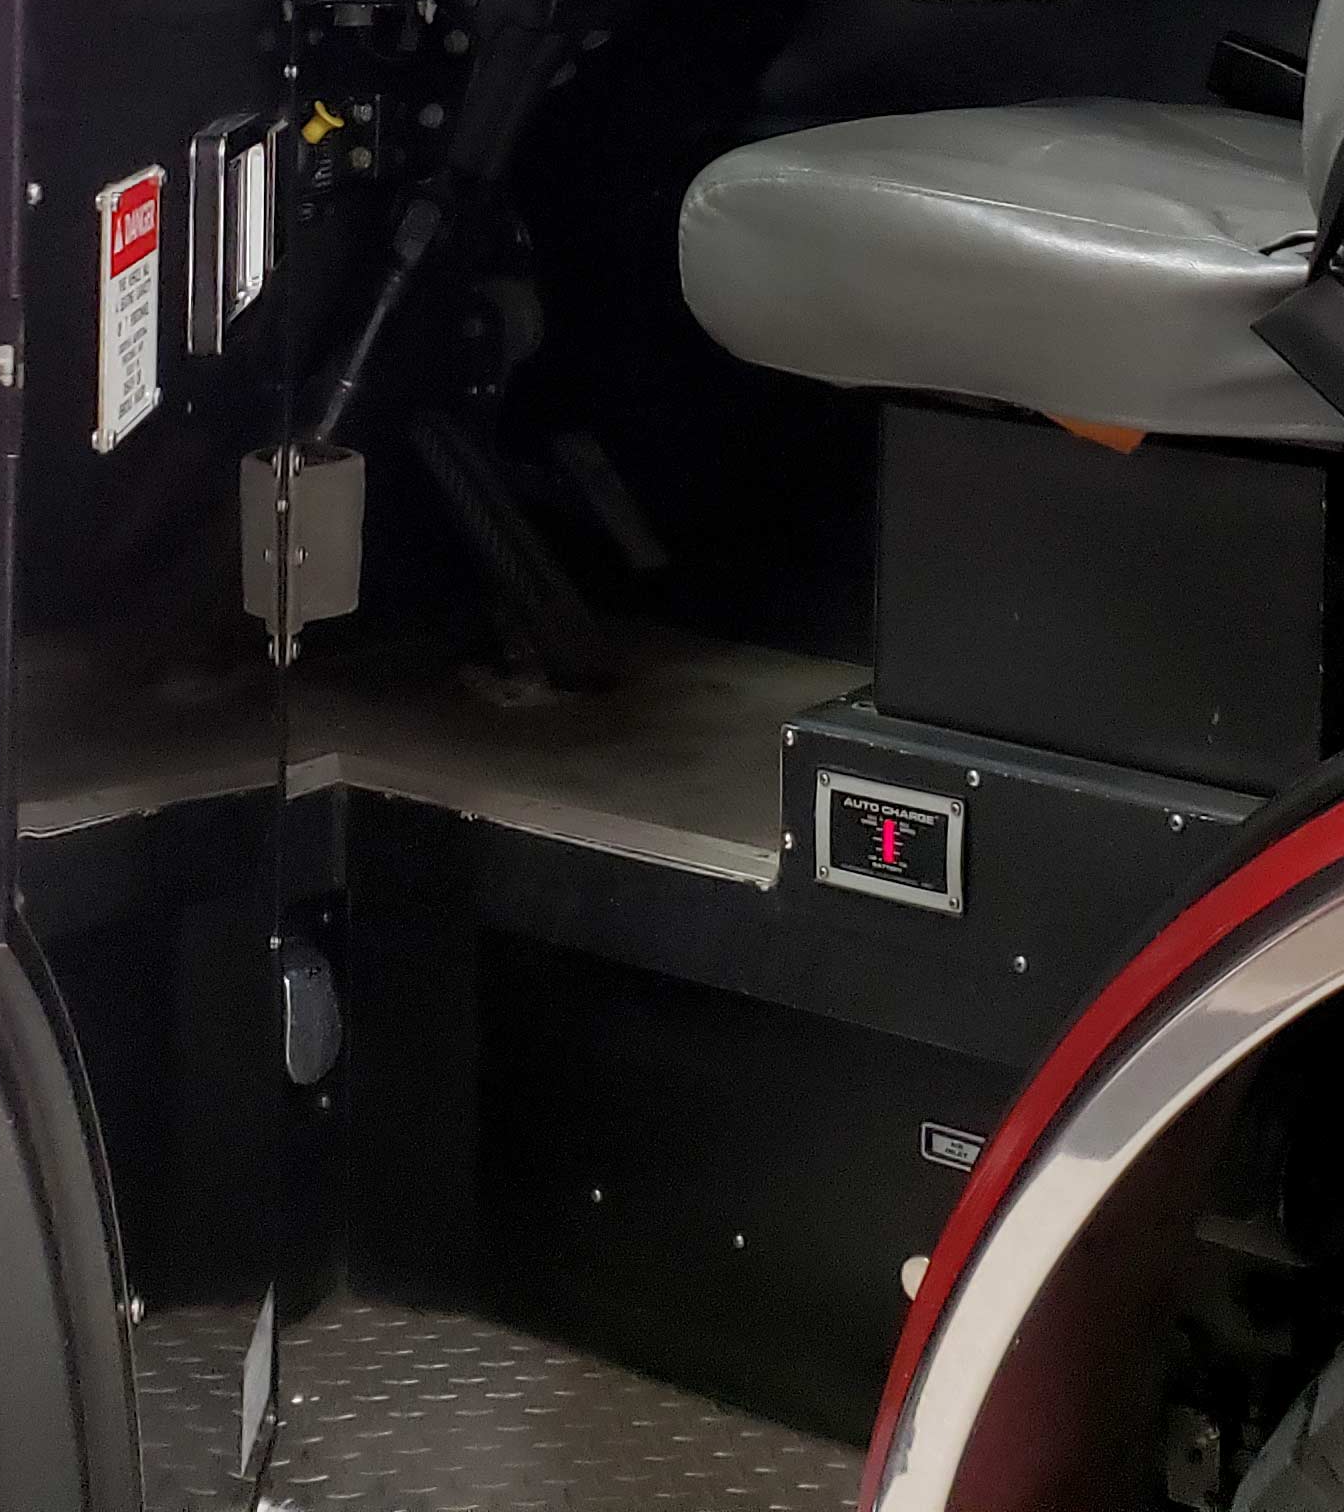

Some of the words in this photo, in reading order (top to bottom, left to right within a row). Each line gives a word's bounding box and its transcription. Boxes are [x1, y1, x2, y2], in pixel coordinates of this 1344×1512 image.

[125, 199, 155, 245] DANGER
[843, 796, 880, 813] AUTO
[881, 805, 935, 826] CHARGE
